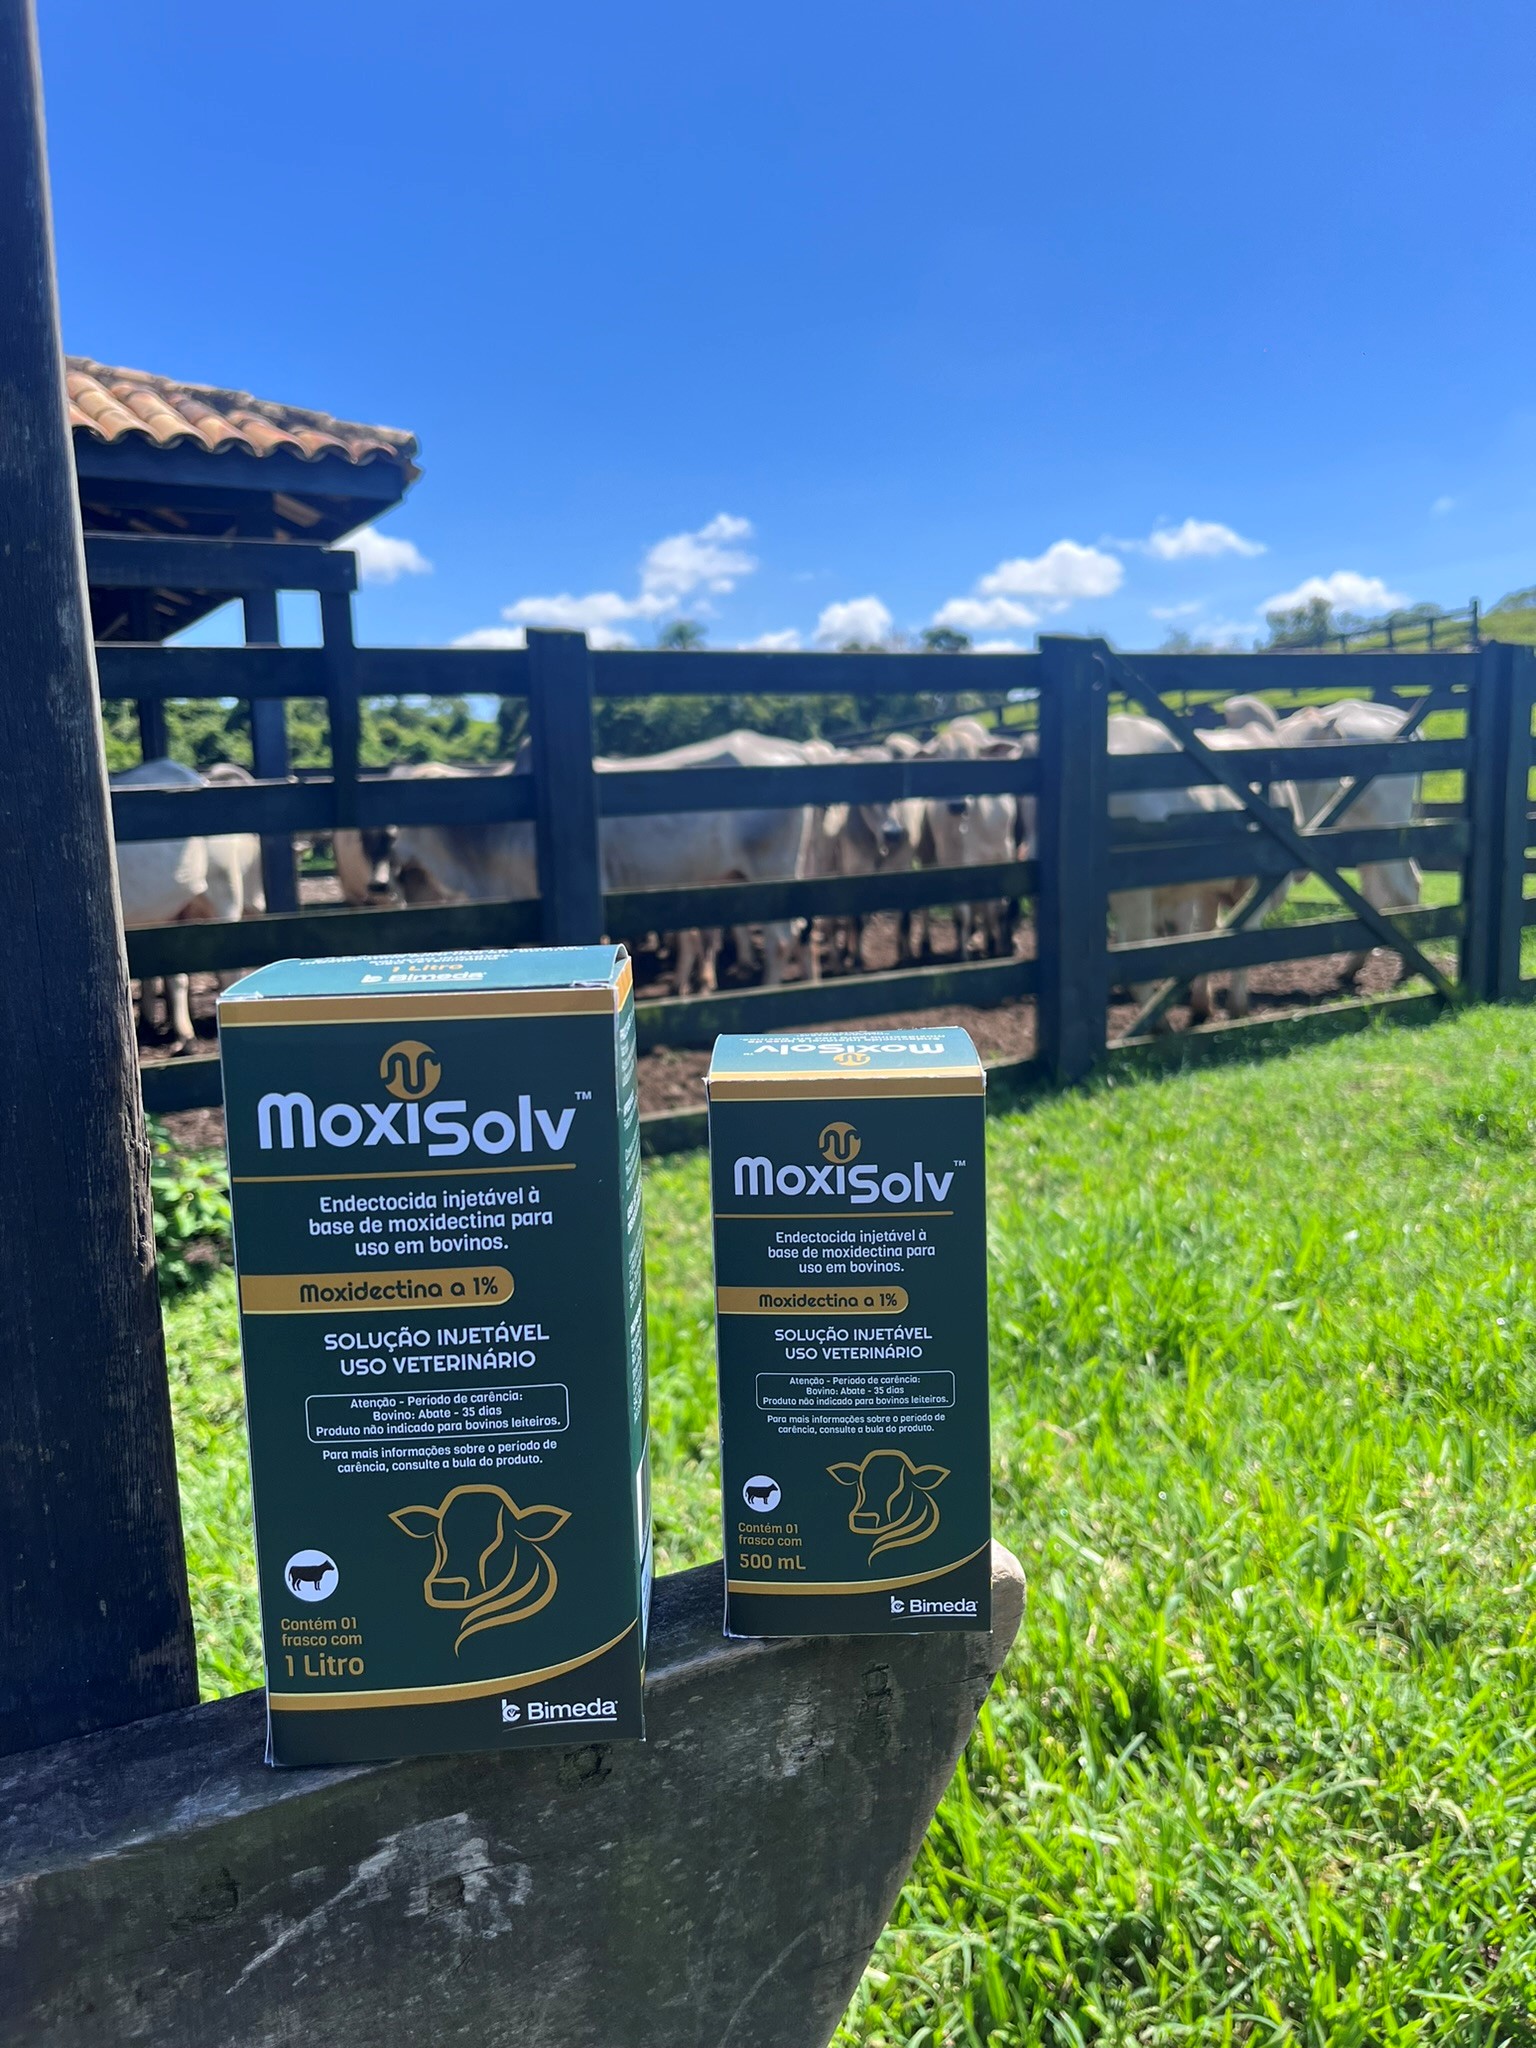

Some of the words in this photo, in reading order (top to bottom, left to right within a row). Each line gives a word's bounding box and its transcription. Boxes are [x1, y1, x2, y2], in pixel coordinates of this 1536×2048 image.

[753, 1043, 945, 1056] MoxiSolv
[257, 1092, 576, 1157] MoxiSolv
[734, 1156, 954, 1204] MoxiSolv
[320, 1192, 437, 1213] Endectocida
[443, 1187, 523, 1210] injetável
[529, 1186, 540, 1203] à
[309, 1218, 354, 1235] base
[359, 1216, 382, 1233] de
[389, 1213, 505, 1232] moxidectina
[512, 1210, 553, 1230] para
[776, 1230, 856, 1243] Endectocida
[860, 1229, 915, 1244] injetável
[919, 1229, 926, 1241] à
[355, 1241, 389, 1256] uso
[395, 1239, 424, 1254] em
[430, 1234, 509, 1253] bovinos.
[768, 1246, 798, 1258] base
[802, 1247, 818, 1258] de
[822, 1246, 902, 1258] moxidectina
[907, 1246, 935, 1258] para
[799, 1262, 822, 1273] uso
[826, 1262, 846, 1273] em
[850, 1260, 904, 1273] bovinos.
[300, 1280, 442, 1302] Moxidectina
[450, 1282, 465, 1296] a
[473, 1276, 498, 1295] 1%
[759, 1294, 858, 1307] Moxidectina
[864, 1296, 874, 1306] a
[880, 1293, 897, 1306] 1%
[324, 1327, 430, 1352] SOLUÇÃO
[438, 1322, 549, 1345] INJETÁVEL
[775, 1327, 849, 1344] SOLUÇÃO
[854, 1325, 932, 1341] INJETÁVEL
[785, 1348, 817, 1359] USO
[822, 1344, 922, 1359] VETERINÁRIO
[340, 1358, 386, 1376] USO
[393, 1348, 536, 1373] VETERINÁRIO
[790, 1377, 824, 1386] Atenção
[868, 1376, 878, 1384] de
[806, 1387, 838, 1395] Bovino:
[841, 1387, 865, 1395] Abate
[887, 1386, 904, 1394] dias
[350, 1397, 396, 1409] Atenção
[408, 1393, 450, 1406] Período
[454, 1392, 467, 1404] de
[470, 1390, 522, 1403] carência:
[763, 1397, 797, 1405] Produto
[817, 1397, 853, 1406] indicado
[855, 1398, 874, 1406] para
[876, 1396, 909, 1404] bovinos
[911, 1395, 949, 1404] leiteiros.
[373, 1410, 415, 1421] Bovino:
[419, 1408, 450, 1419] Abate
[462, 1407, 475, 1417] 35
[478, 1405, 502, 1416] dias
[767, 1415, 786, 1423] Para
[789, 1415, 809, 1423] mais
[812, 1414, 864, 1424] informações
[867, 1414, 891, 1423] sobre
[934, 1413, 945, 1421] de
[316, 1425, 360, 1436] Produto
[364, 1424, 384, 1434] não
[387, 1421, 434, 1434] indicado
[438, 1421, 462, 1433] para
[466, 1418, 508, 1430] bovinos
[511, 1415, 560, 1428] leiteiros.
[819, 1425, 856, 1434] consulte
[865, 1424, 883, 1433] bula
[886, 1424, 896, 1433] do
[899, 1424, 934, 1433] produto.
[323, 1450, 348, 1460] Para
[352, 1448, 378, 1459] mais
[381, 1445, 450, 1459] informações
[454, 1443, 485, 1454] sobre
[488, 1444, 495, 1453] o
[498, 1440, 540, 1453] período
[543, 1438, 557, 1449] de
[337, 1460, 389, 1474] carência,
[392, 1458, 440, 1470] consulte
[442, 1460, 449, 1468] a
[452, 1456, 476, 1468] bula
[479, 1455, 493, 1466] do
[496, 1453, 542, 1467] produto.
[738, 1522, 782, 1534] Contém
[786, 1524, 798, 1534] 01
[739, 1535, 774, 1546] frasco
[777, 1536, 802, 1546] com
[740, 1554, 772, 1569] 500
[778, 1555, 806, 1569] mL
[910, 1598, 978, 1613] Bimeda
[281, 1617, 336, 1631] Contém
[341, 1617, 357, 1630] 01
[282, 1634, 327, 1647] frasco
[331, 1632, 362, 1645] com
[286, 1655, 294, 1676] 1
[304, 1652, 365, 1677] Litro
[528, 1697, 618, 1721] Bimeda
